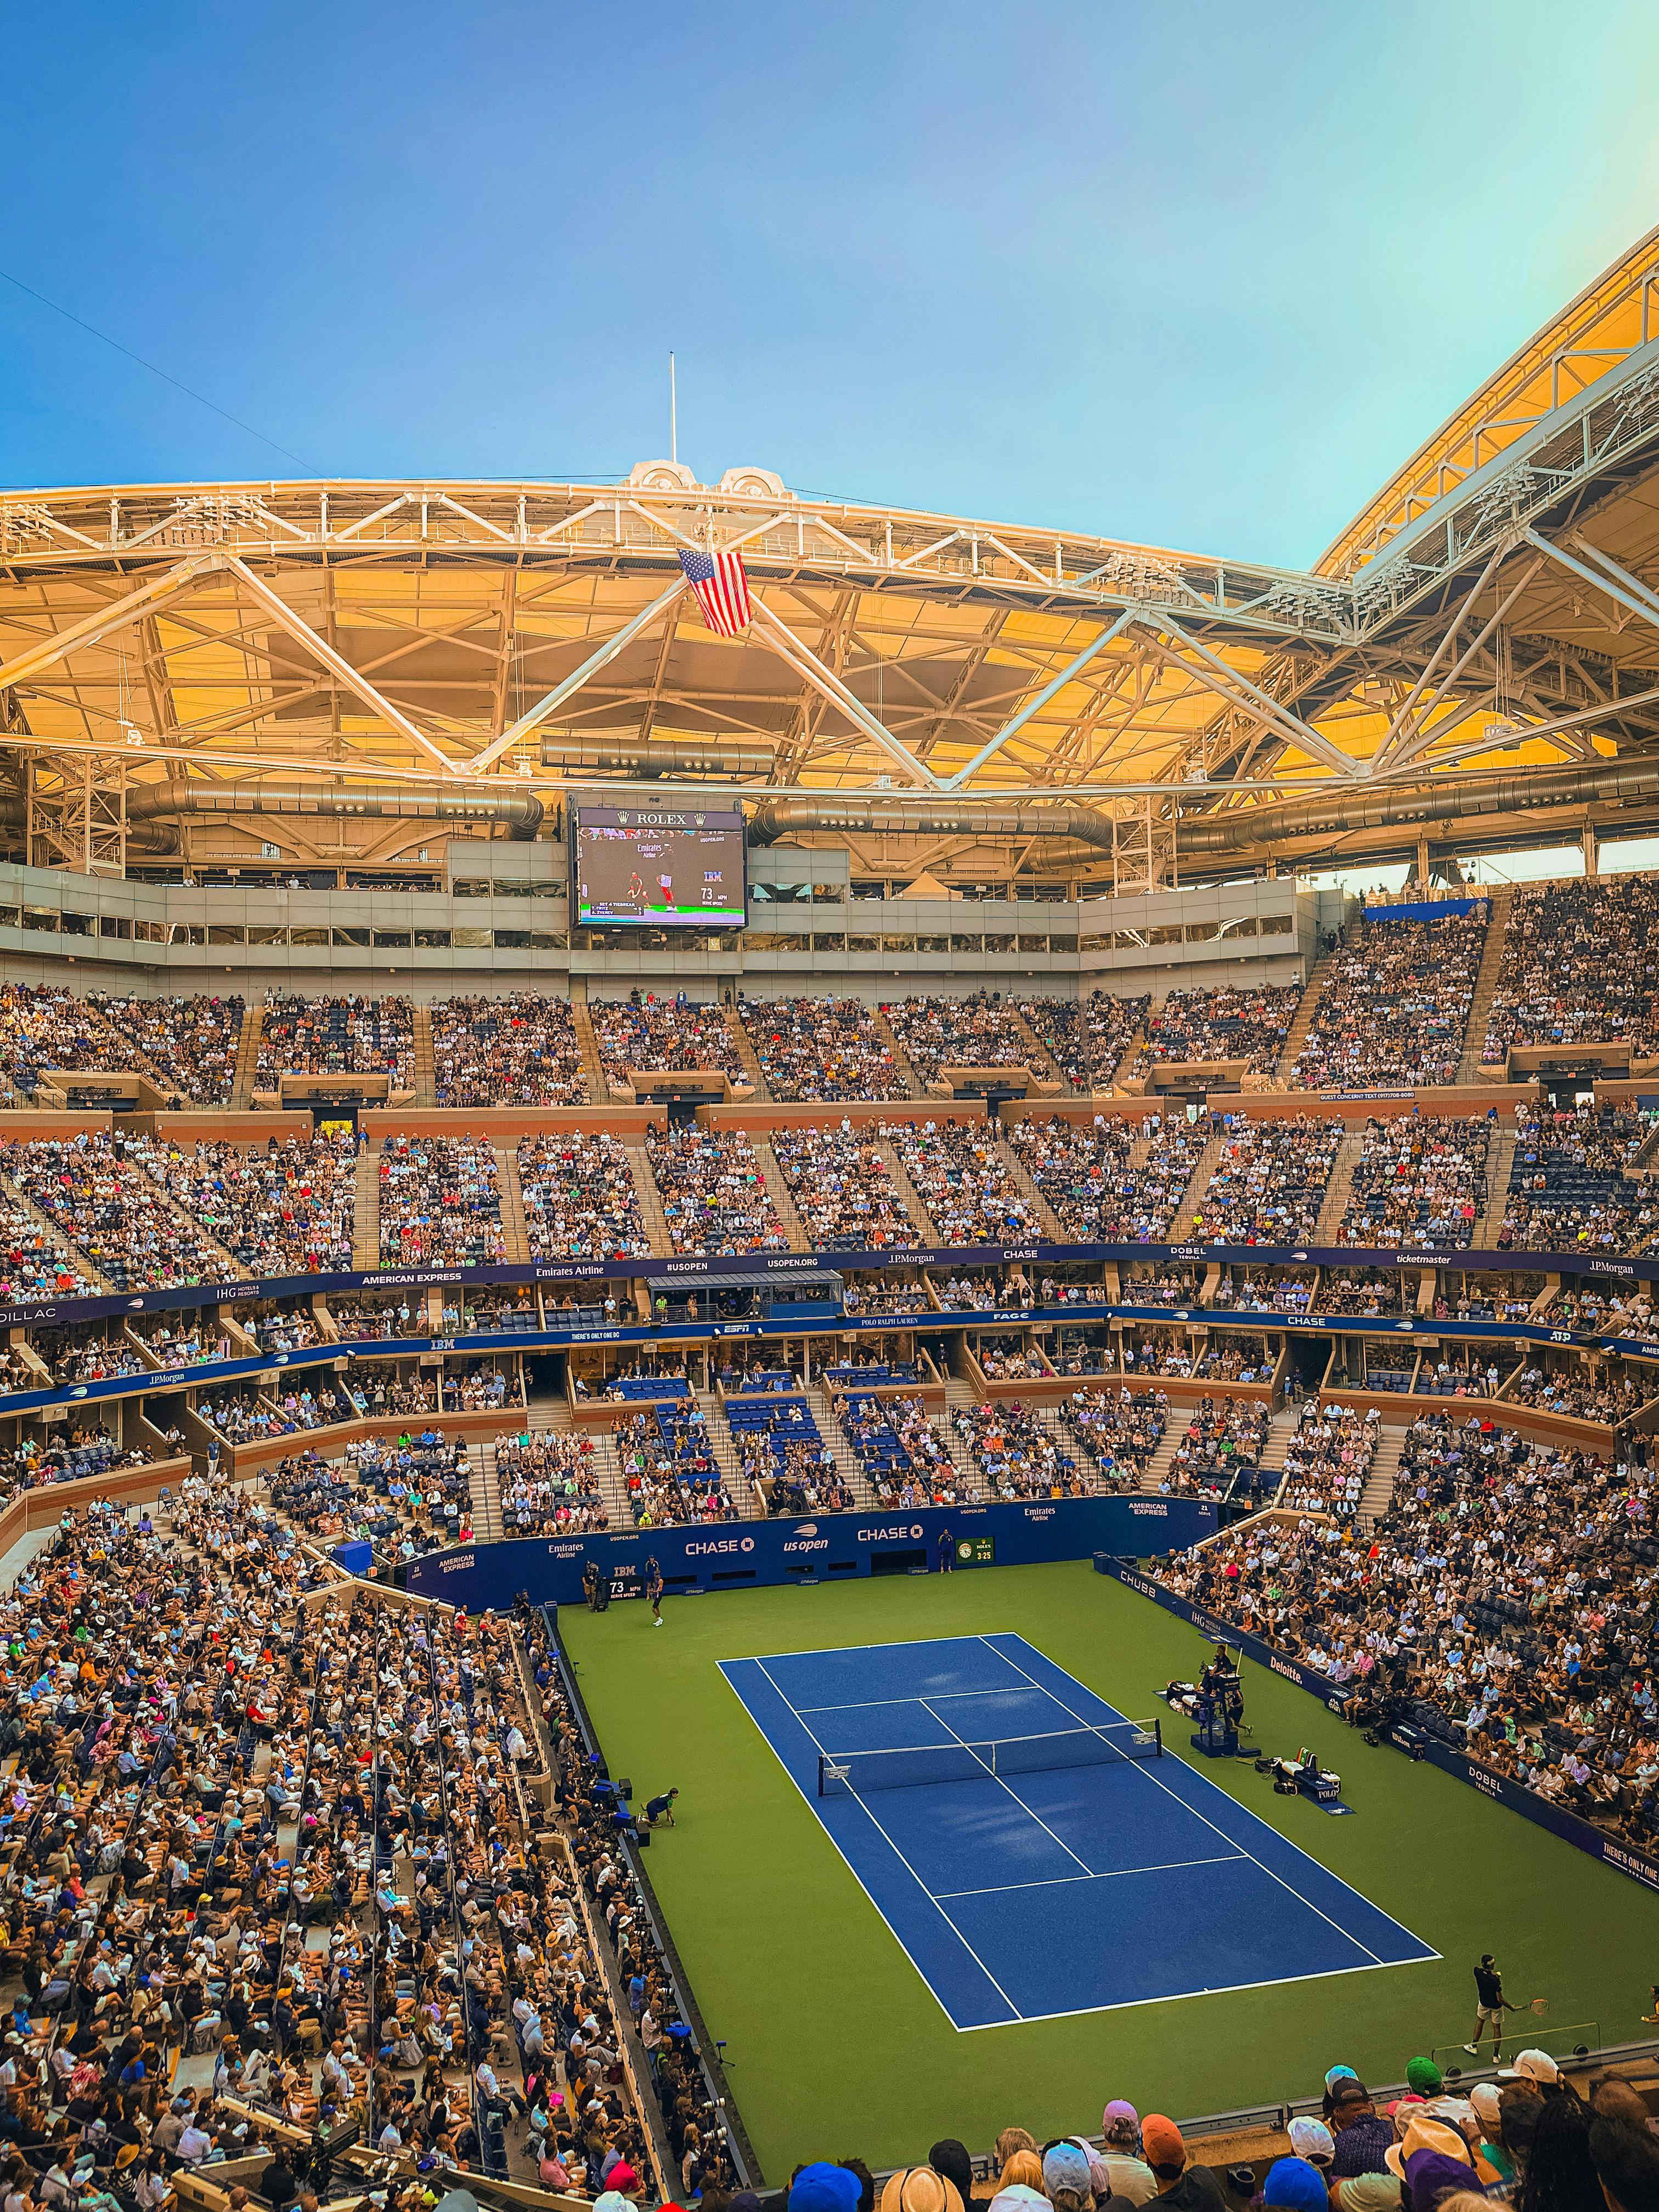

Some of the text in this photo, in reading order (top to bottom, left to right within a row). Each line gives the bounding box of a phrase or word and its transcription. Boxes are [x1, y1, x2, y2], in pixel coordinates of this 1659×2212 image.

[636, 813, 687, 825] ROLEX
[637, 844, 662, 853] Emirates
[704, 871, 723, 882] IBM
[701, 888, 713, 900] 73
[1003, 1250, 1038, 1259] CHASE
[1396, 1254, 1452, 1264] ticketmaster
[667, 1262, 708, 1271] #USOPEN
[768, 1258, 818, 1267] USOPEN.ORG
[536, 1266, 604, 1277] Emirates Airline
[362, 1272, 462, 1285] AMERICAN EXPRESS
[217, 1288, 237, 1299] IHG
[1288, 1317, 1326, 1326] CHASE
[724, 1324, 749, 1333] ESPN
[1549, 1331, 1571, 1342] ATP
[431, 1339, 455, 1350] IBM
[1024, 1507, 1056, 1516] Emirates
[857, 1527, 908, 1542] CHASE
[549, 1543, 584, 1554] Emirates
[685, 1539, 738, 1555] CHASE
[783, 1538, 828, 1553] us open
[439, 1554, 475, 1568] AMERICAN
[977, 1551, 991, 1560] 3:25
[443, 1560, 475, 1573] EXPRESS
[614, 1565, 636, 1577] IBM
[610, 1582, 624, 1593] 73
[1120, 1570, 1156, 1598] CHUBB
[1191, 1611, 1205, 1627] IHG
[1270, 1656, 1302, 1685] Deloitte.
[1469, 1766, 1503, 1793] DOBEL
[1318, 1790, 1338, 1799] POLO
[1475, 1781, 1496, 1797] TEQUILA
[1604, 1842, 1658, 1882] THERE'S ONLY ONE
